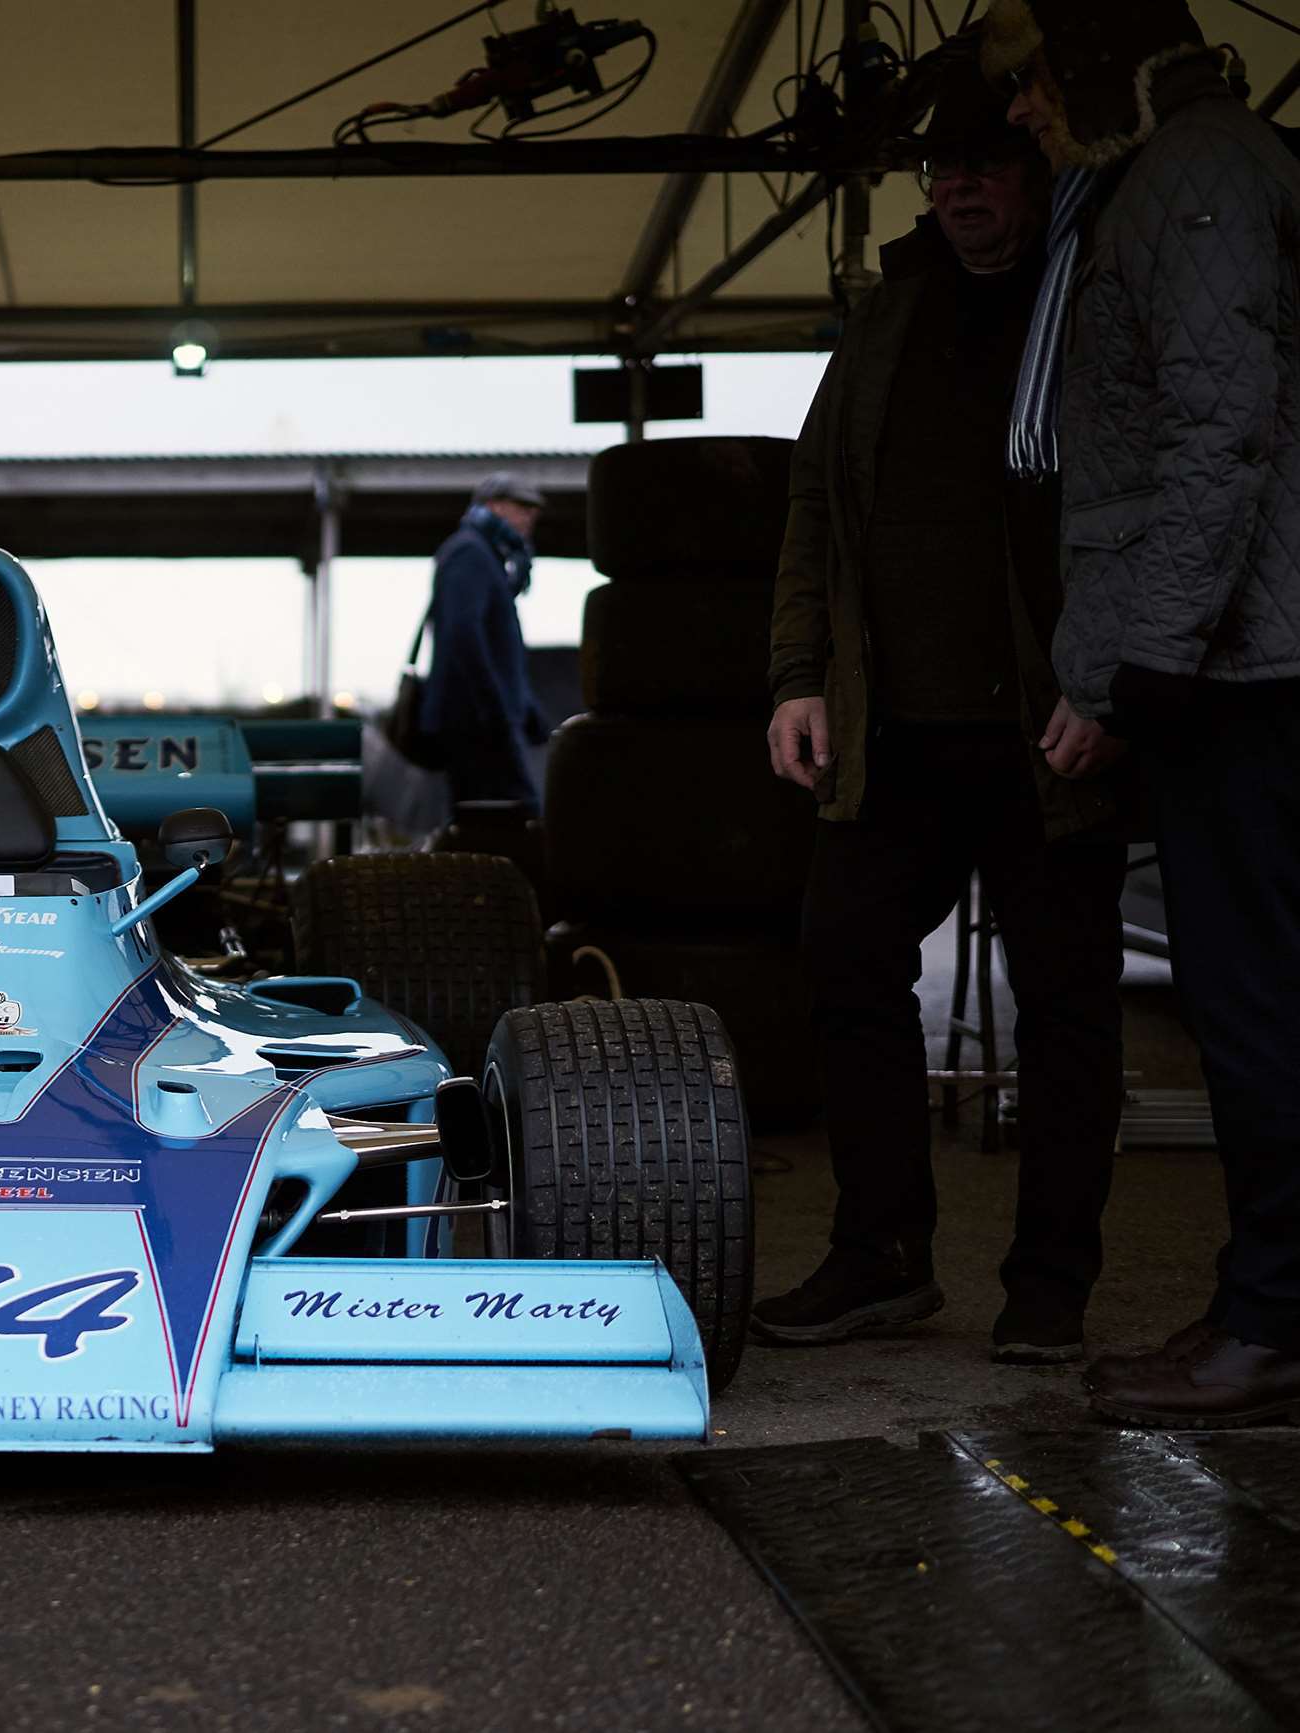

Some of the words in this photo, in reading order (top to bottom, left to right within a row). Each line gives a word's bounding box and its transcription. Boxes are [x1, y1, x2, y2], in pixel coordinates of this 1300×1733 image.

[283, 1290, 444, 1319] Mister
[465, 1292, 622, 1327] Marty
[56, 1395, 170, 1421] RACING
